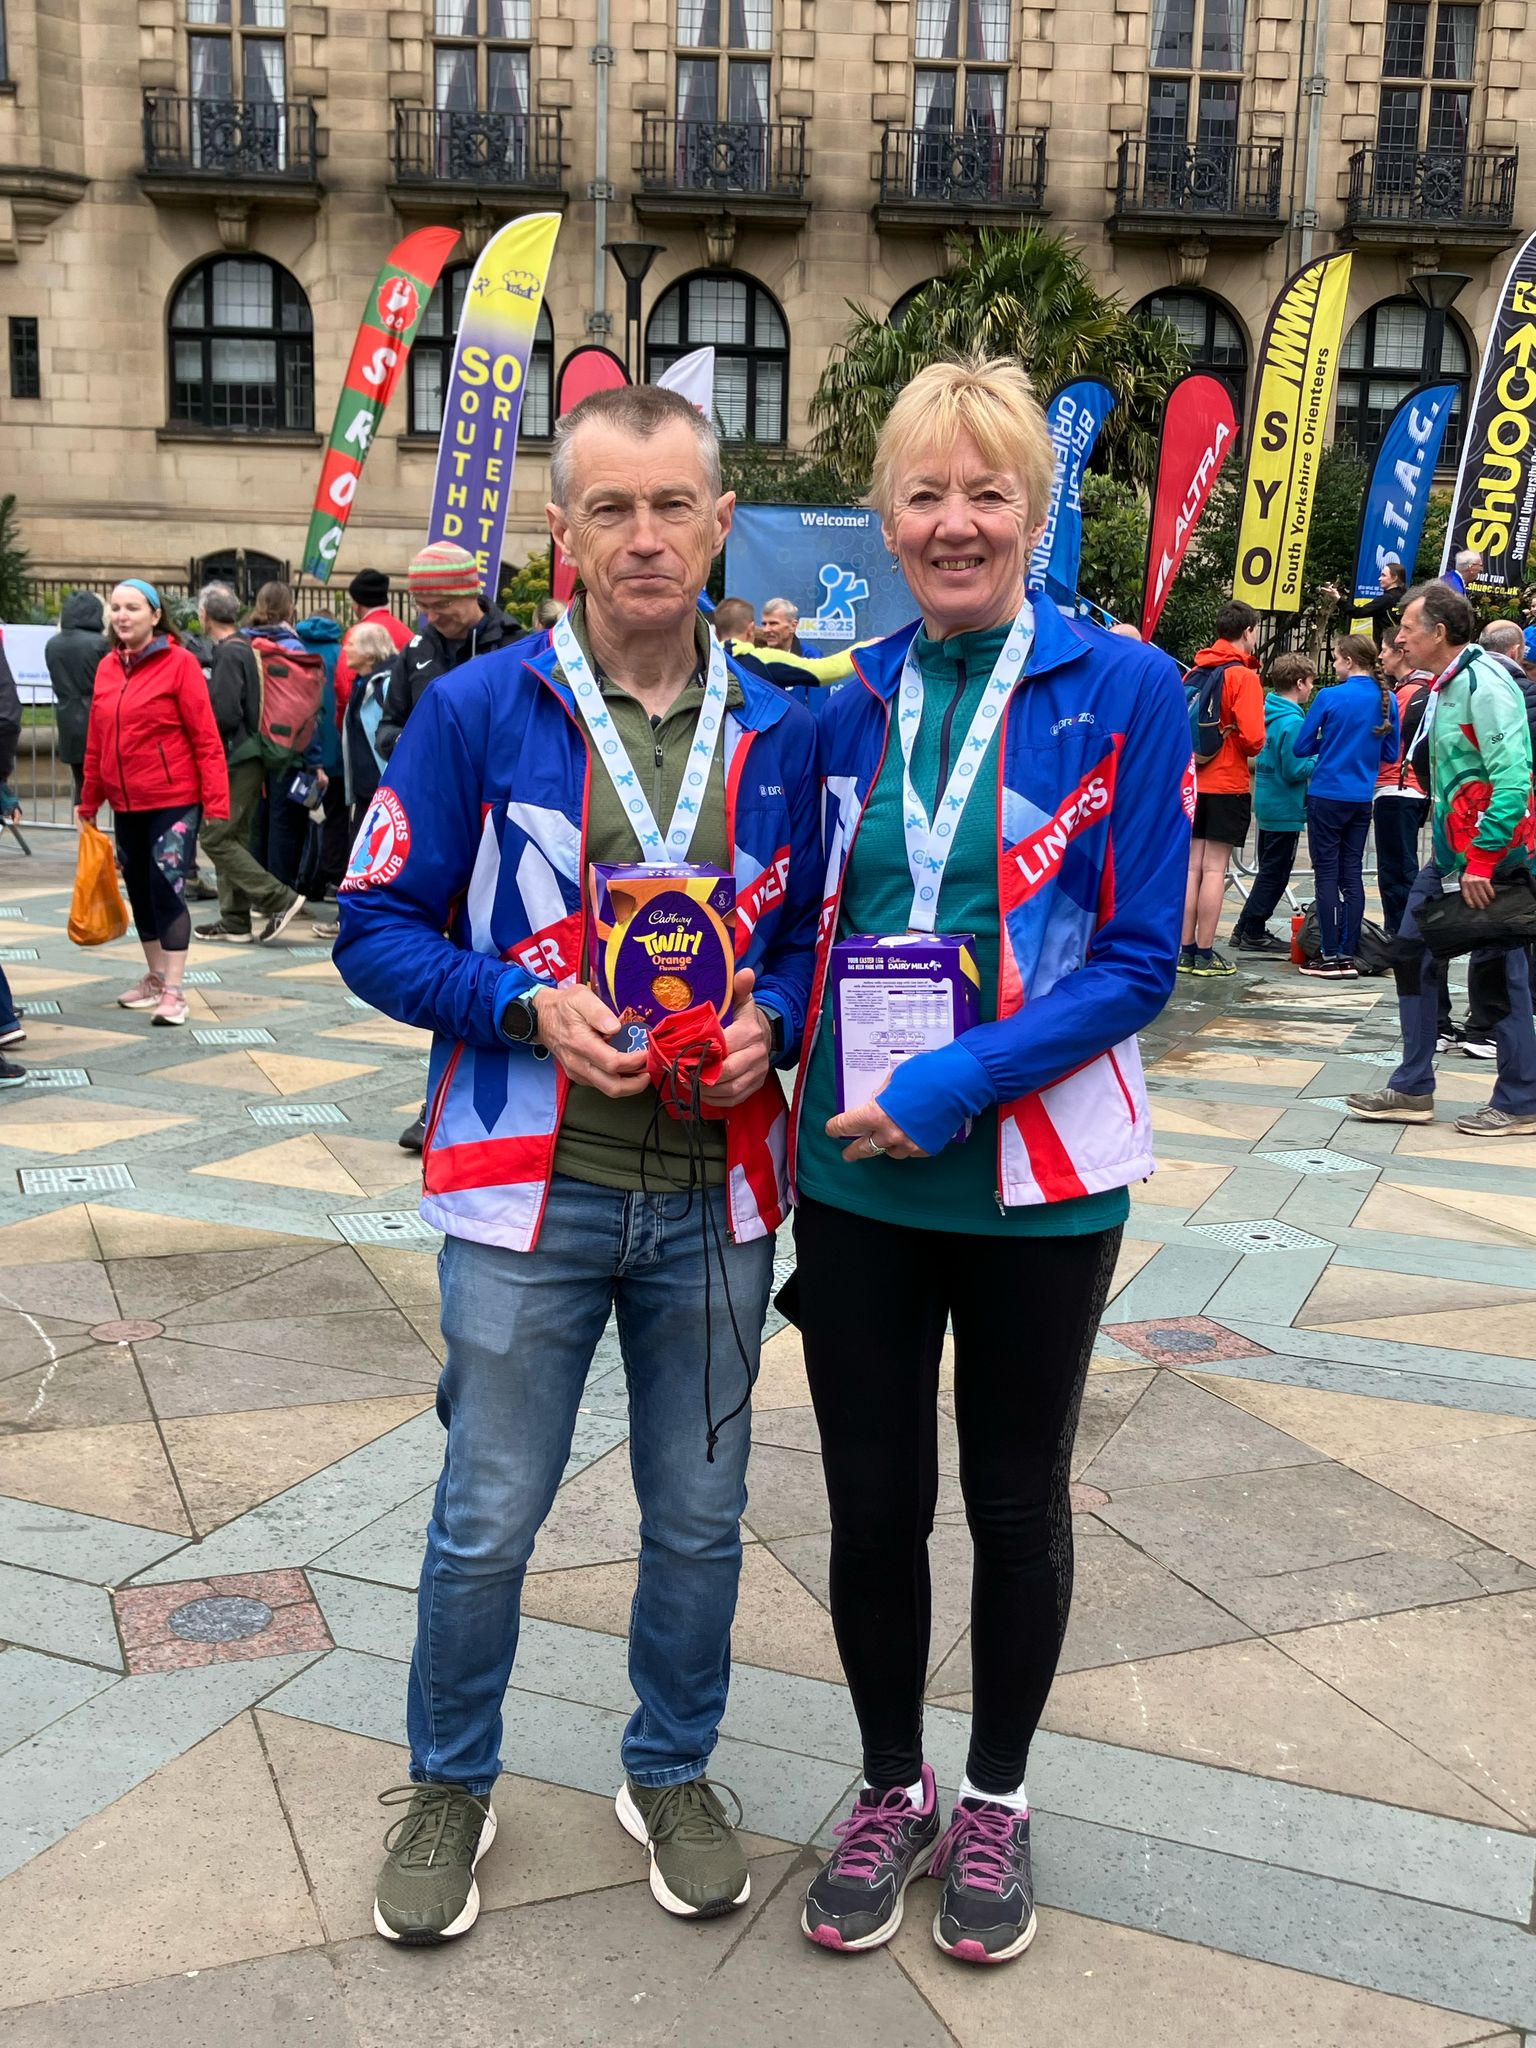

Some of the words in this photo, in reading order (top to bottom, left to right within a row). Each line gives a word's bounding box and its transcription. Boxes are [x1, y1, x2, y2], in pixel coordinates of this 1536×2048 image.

[1302, 347, 1330, 446] Orienteers
[1175, 422, 1230, 552] ALTRA
[1242, 411, 1290, 586] SYO
[1290, 452, 1312, 533] Yorkshire
[801, 513, 869, 527] Welcome!
[1282, 535, 1302, 595] South
[1490, 574, 1505, 584] run
[1015, 777, 1108, 885] LINERS
[370, 854, 403, 885] CLUB
[648, 910, 692, 927] Cadbury
[632, 925, 703, 957] Twirl
[652, 955, 692, 967] Orange
[888, 962, 911, 970] DAIRY
[911, 962, 930, 970] MILK
